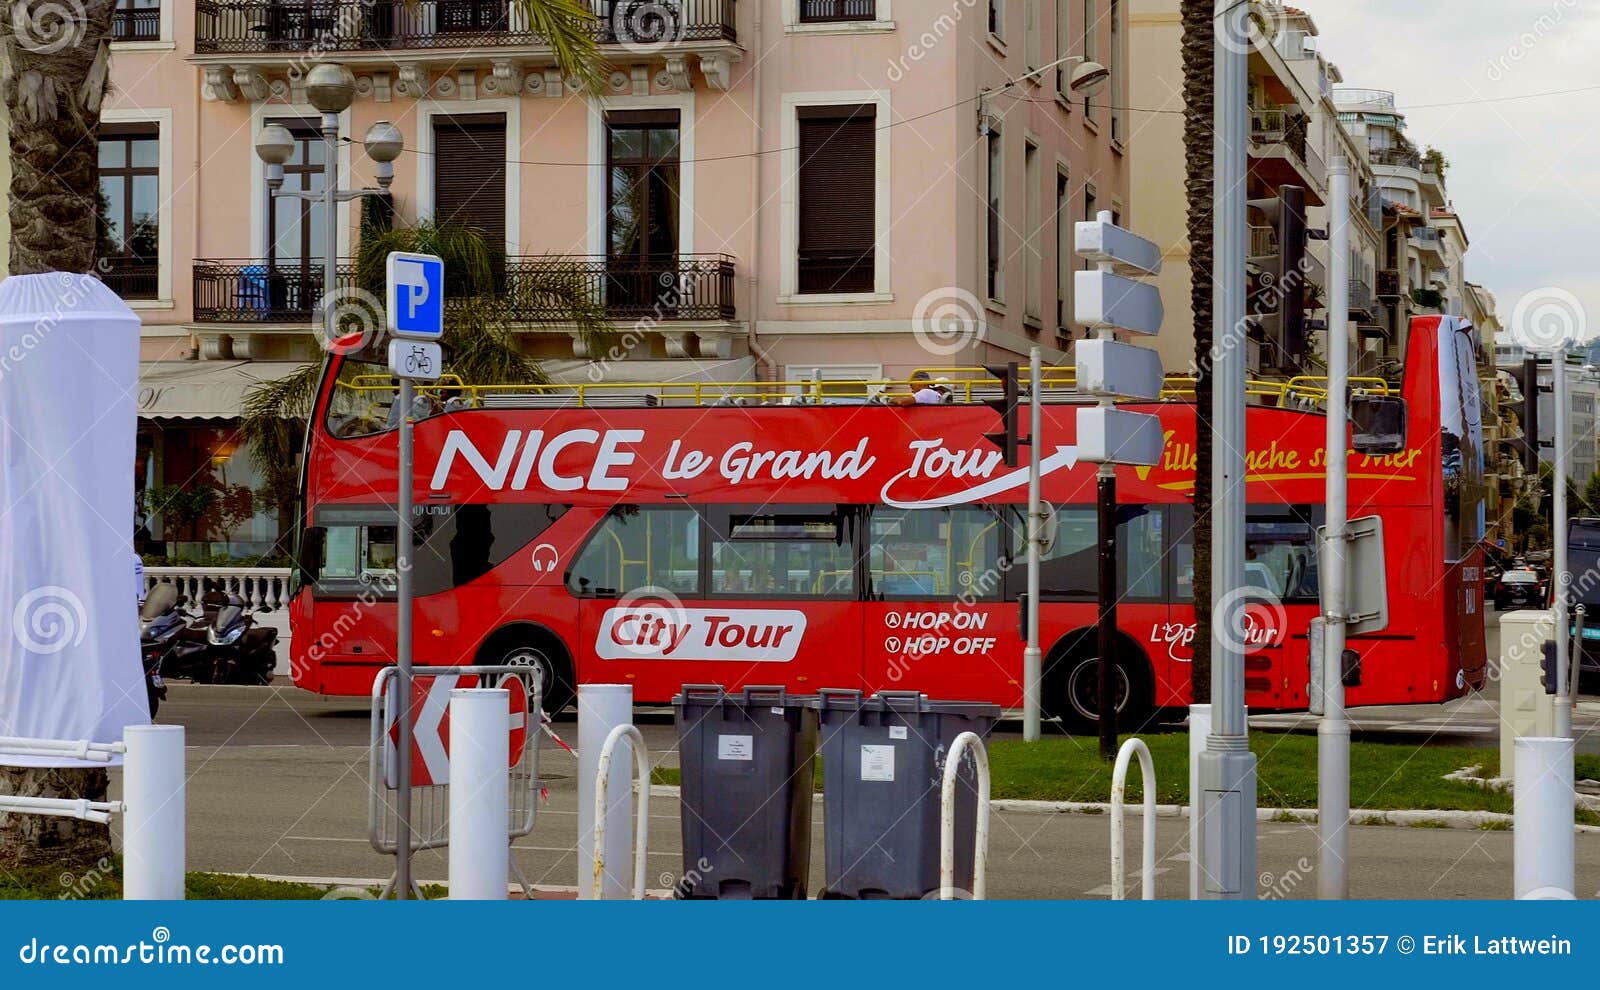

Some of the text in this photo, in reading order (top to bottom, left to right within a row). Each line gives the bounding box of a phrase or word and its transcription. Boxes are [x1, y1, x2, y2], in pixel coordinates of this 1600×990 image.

[430, 429, 645, 491] NICE
[719, 436, 876, 484] Grand
[908, 437, 1004, 479] Tour
[610, 613, 794, 656] City Tour
[902, 611, 989, 630] HOP ON
[902, 636, 997, 655] HOP OFF
